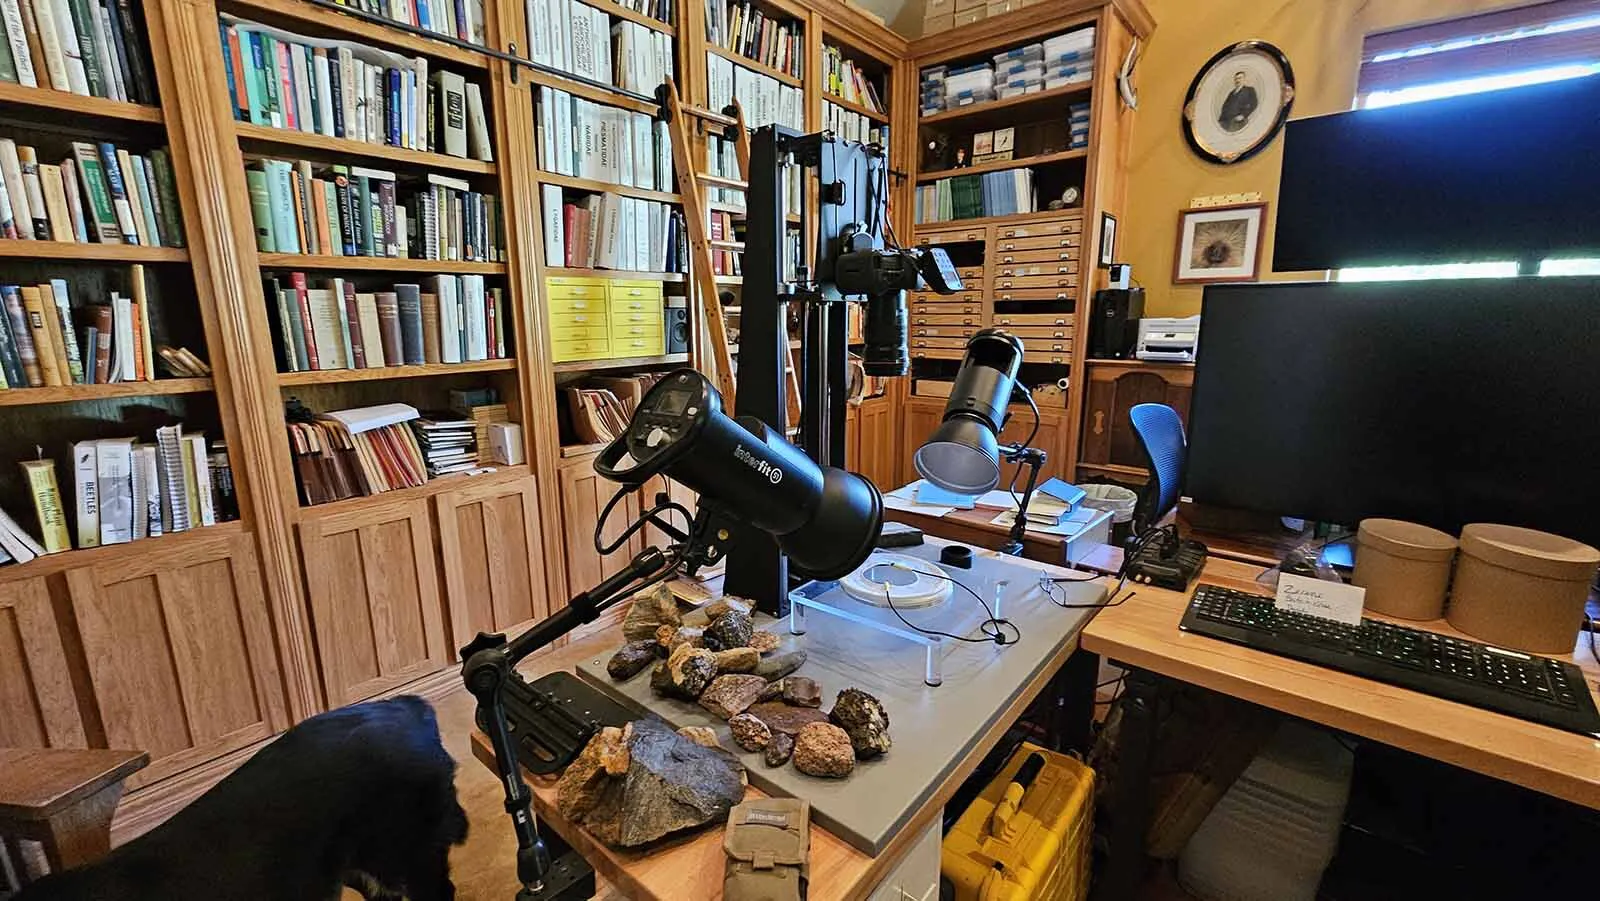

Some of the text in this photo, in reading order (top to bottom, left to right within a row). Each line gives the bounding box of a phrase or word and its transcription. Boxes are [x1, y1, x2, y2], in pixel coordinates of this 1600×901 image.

[15, 39, 30, 73] Panther
[584, 124, 592, 157] NABIDAE
[733, 443, 771, 478] interfit
[86, 482, 96, 516] BEETLES
